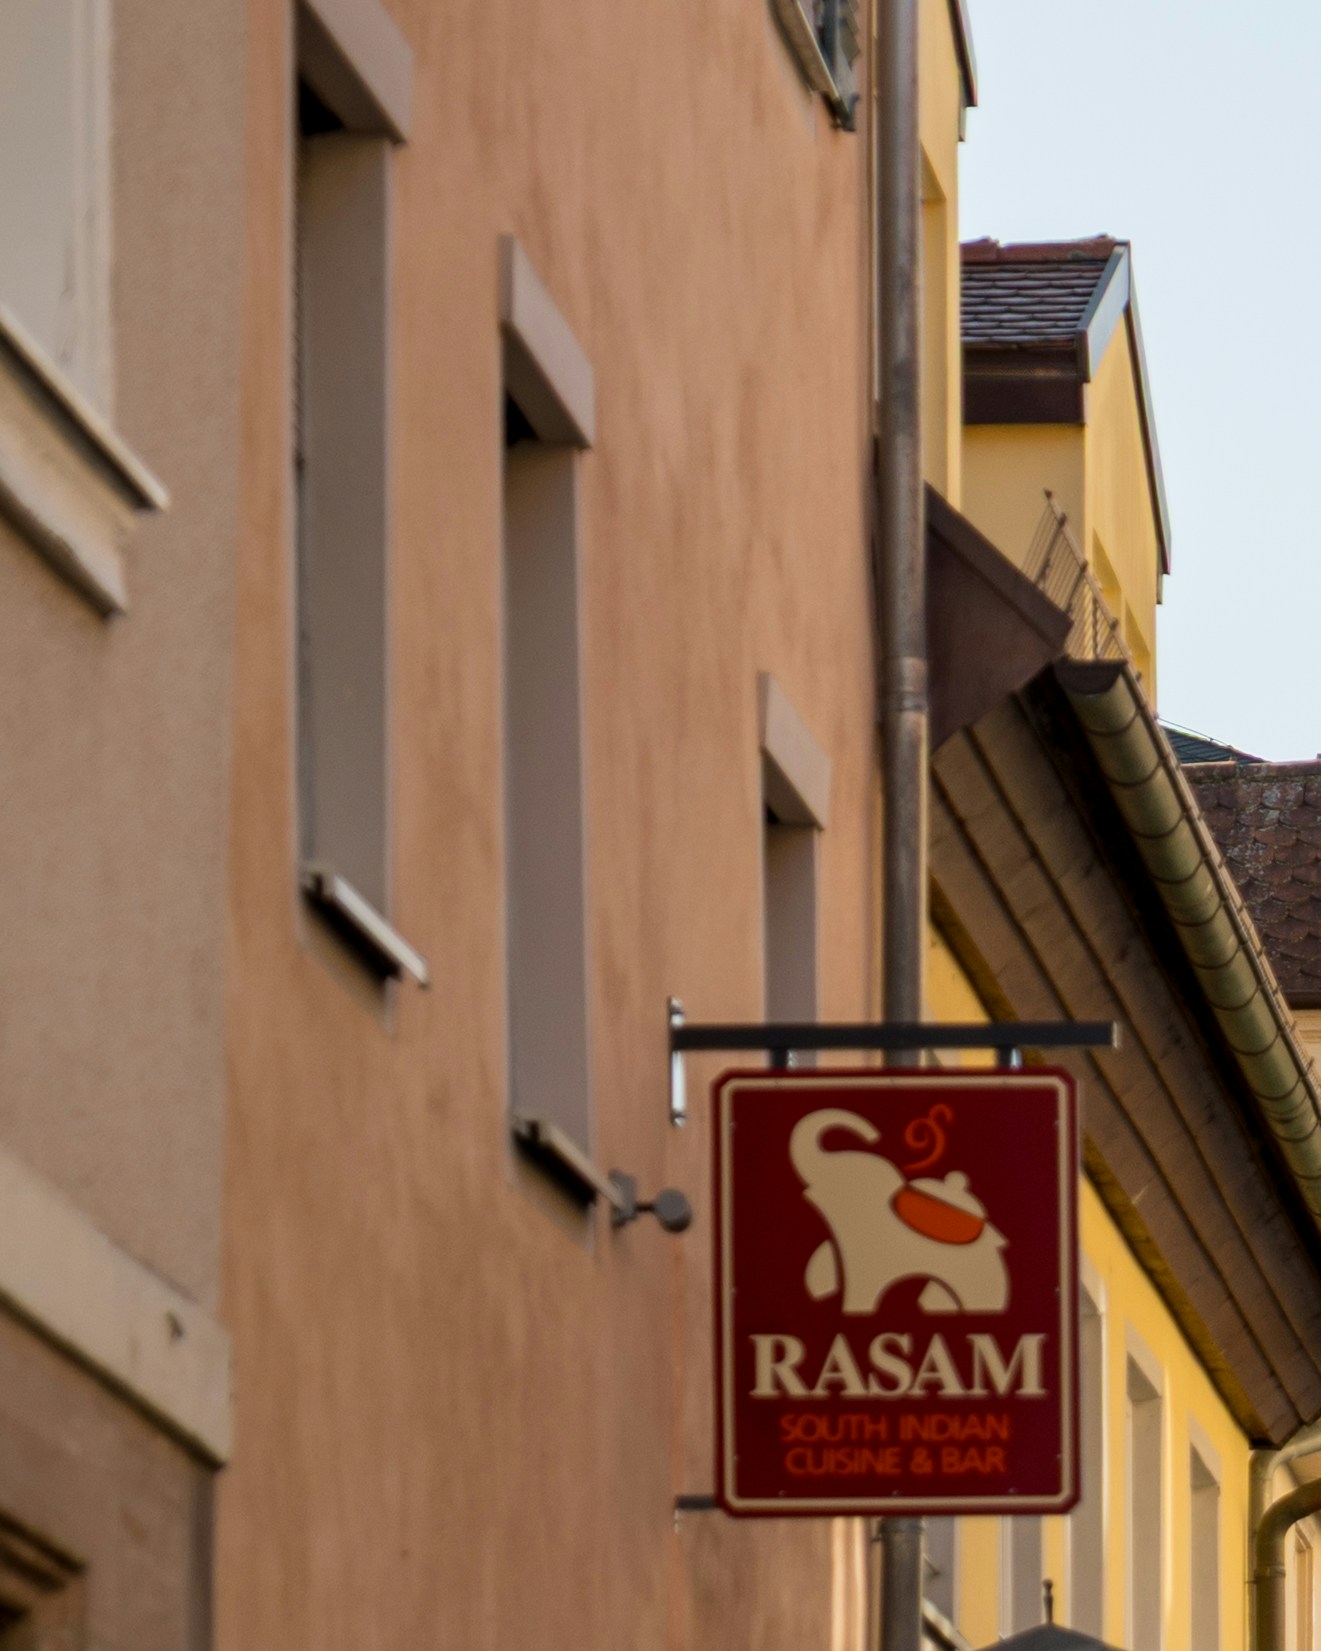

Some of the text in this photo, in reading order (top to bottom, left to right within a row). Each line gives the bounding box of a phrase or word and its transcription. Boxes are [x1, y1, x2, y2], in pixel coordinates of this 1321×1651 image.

[749, 1333, 1047, 1397] RASAM
[780, 1413, 1011, 1442] SOUTH INDIAN
[785, 1446, 1007, 1475] CUISINE & BAR
